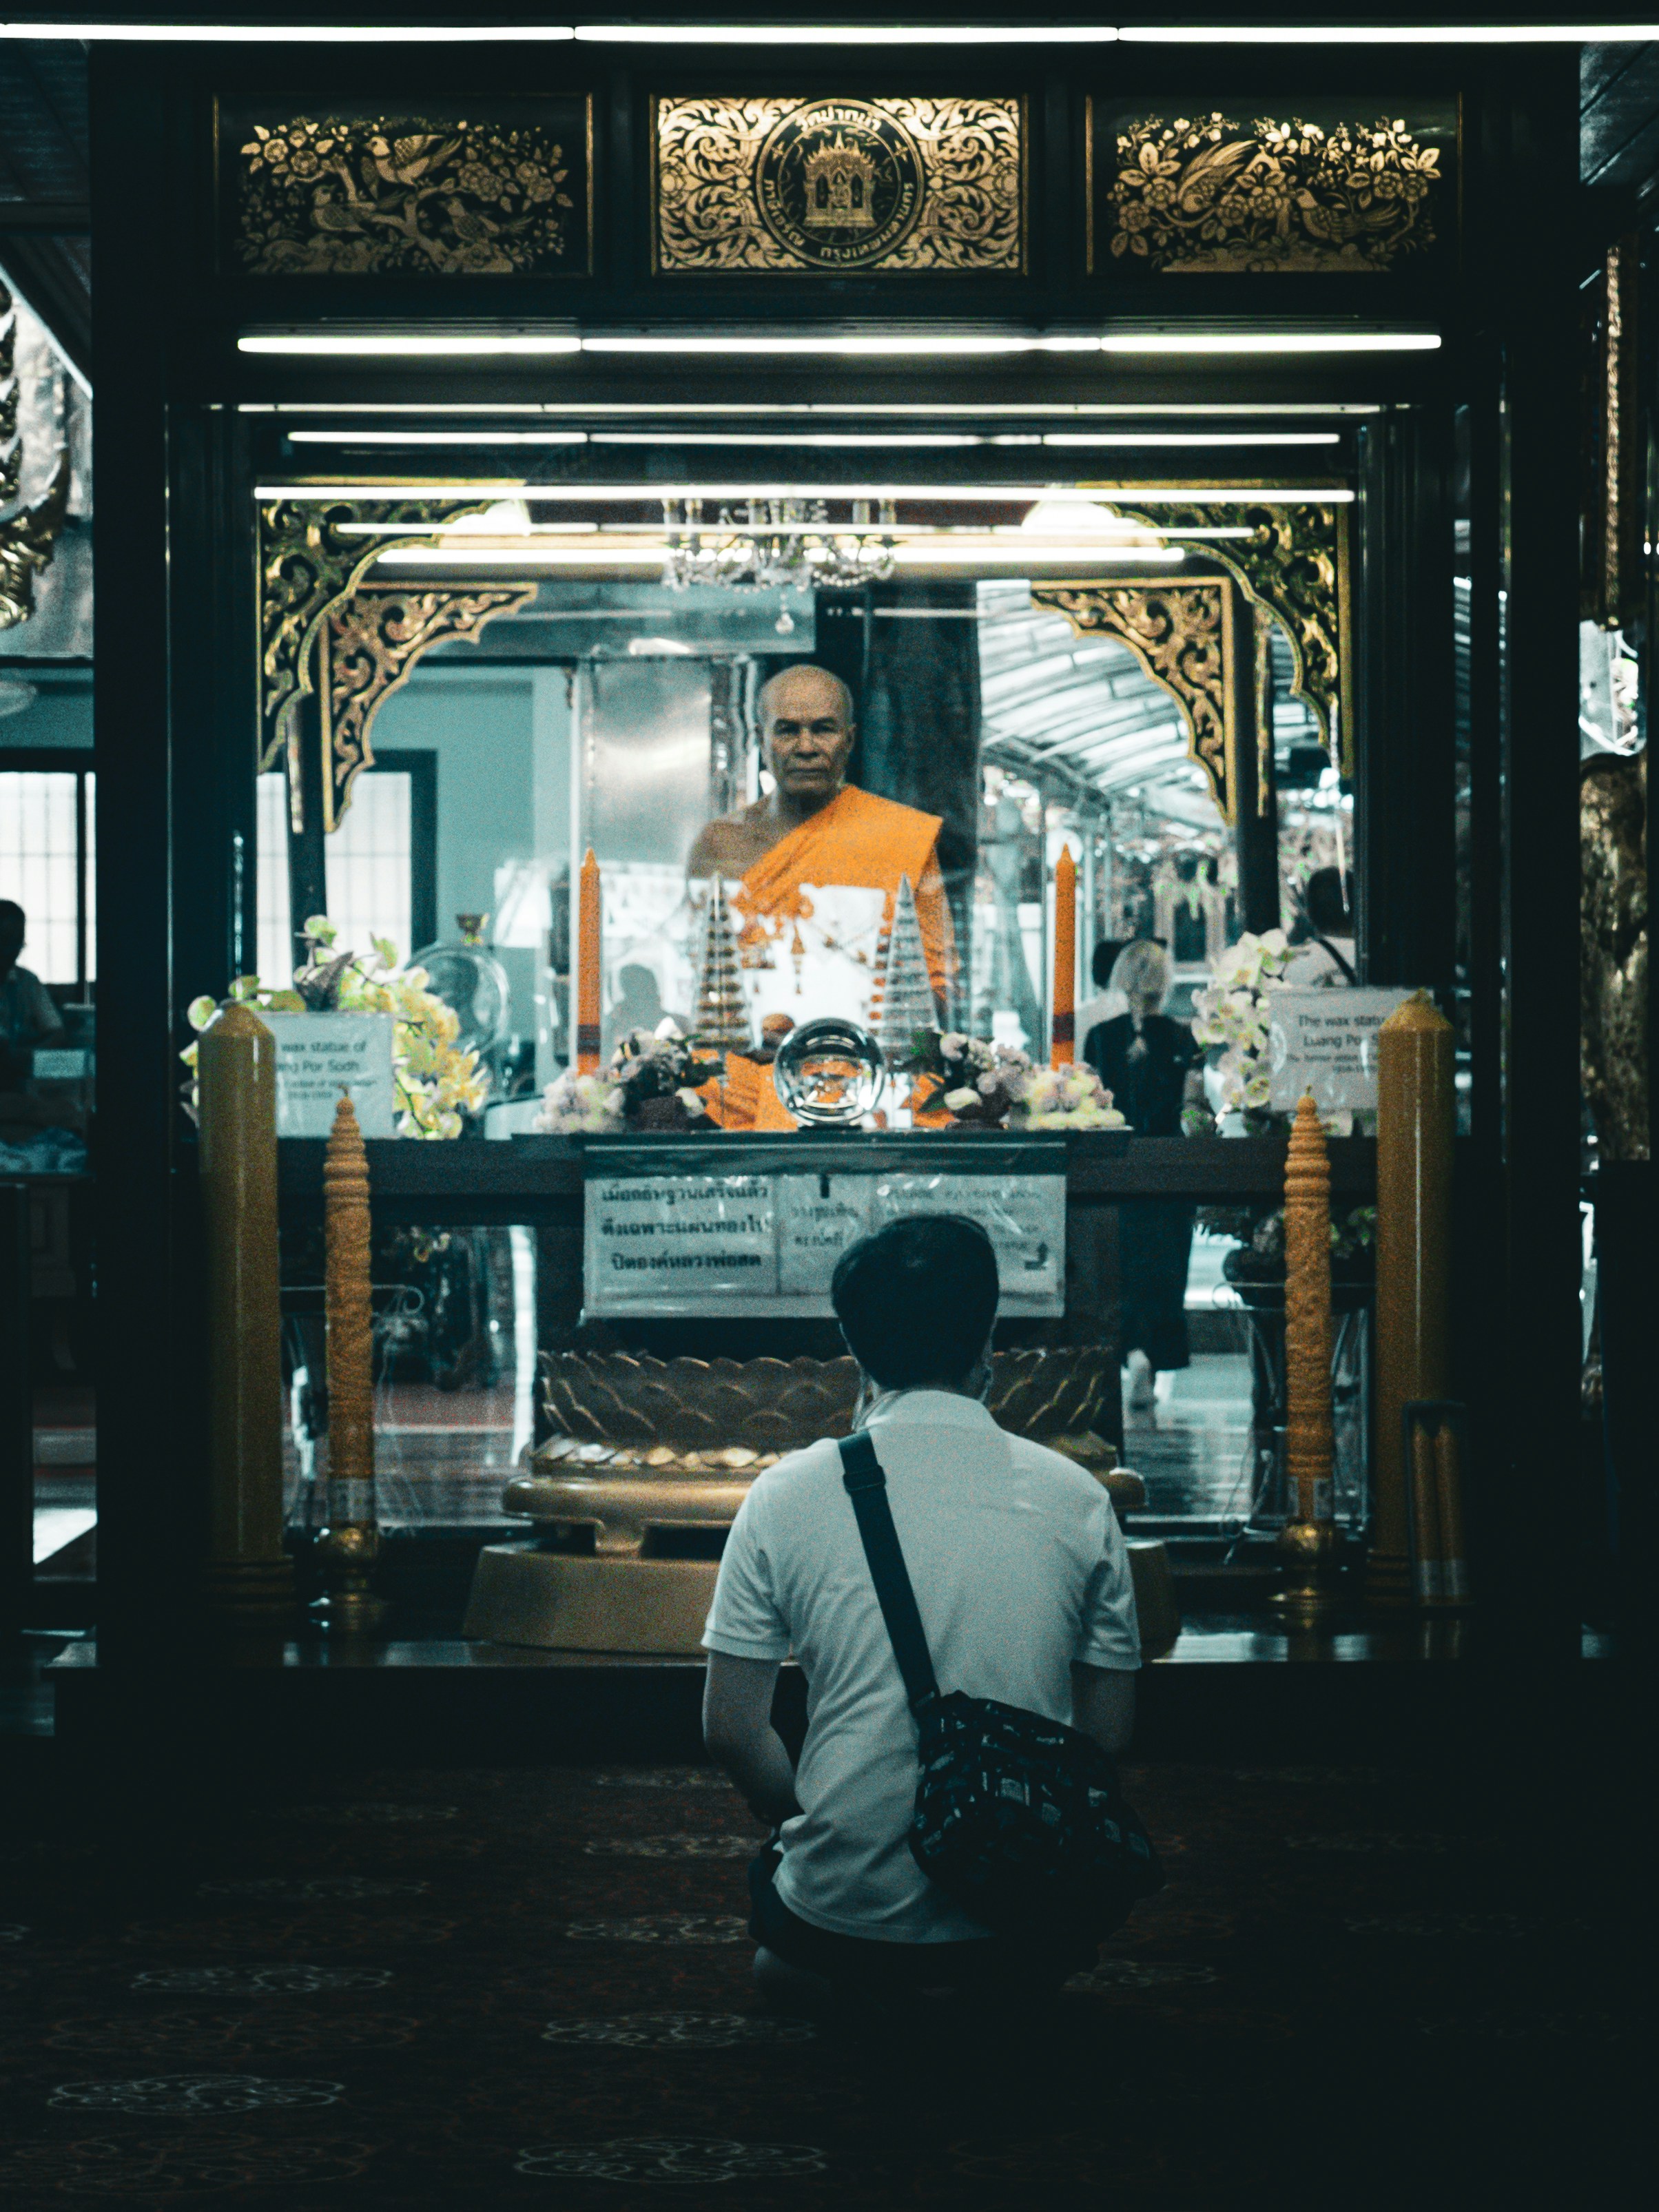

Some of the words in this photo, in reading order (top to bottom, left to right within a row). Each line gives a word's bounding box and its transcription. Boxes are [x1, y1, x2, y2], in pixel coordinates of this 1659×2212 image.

[1299, 1015, 1321, 1027] The
[311, 1041, 349, 1053] statue
[353, 1040, 367, 1053] of
[1304, 1034, 1343, 1049] Luang
[302, 1059, 323, 1073] Por
